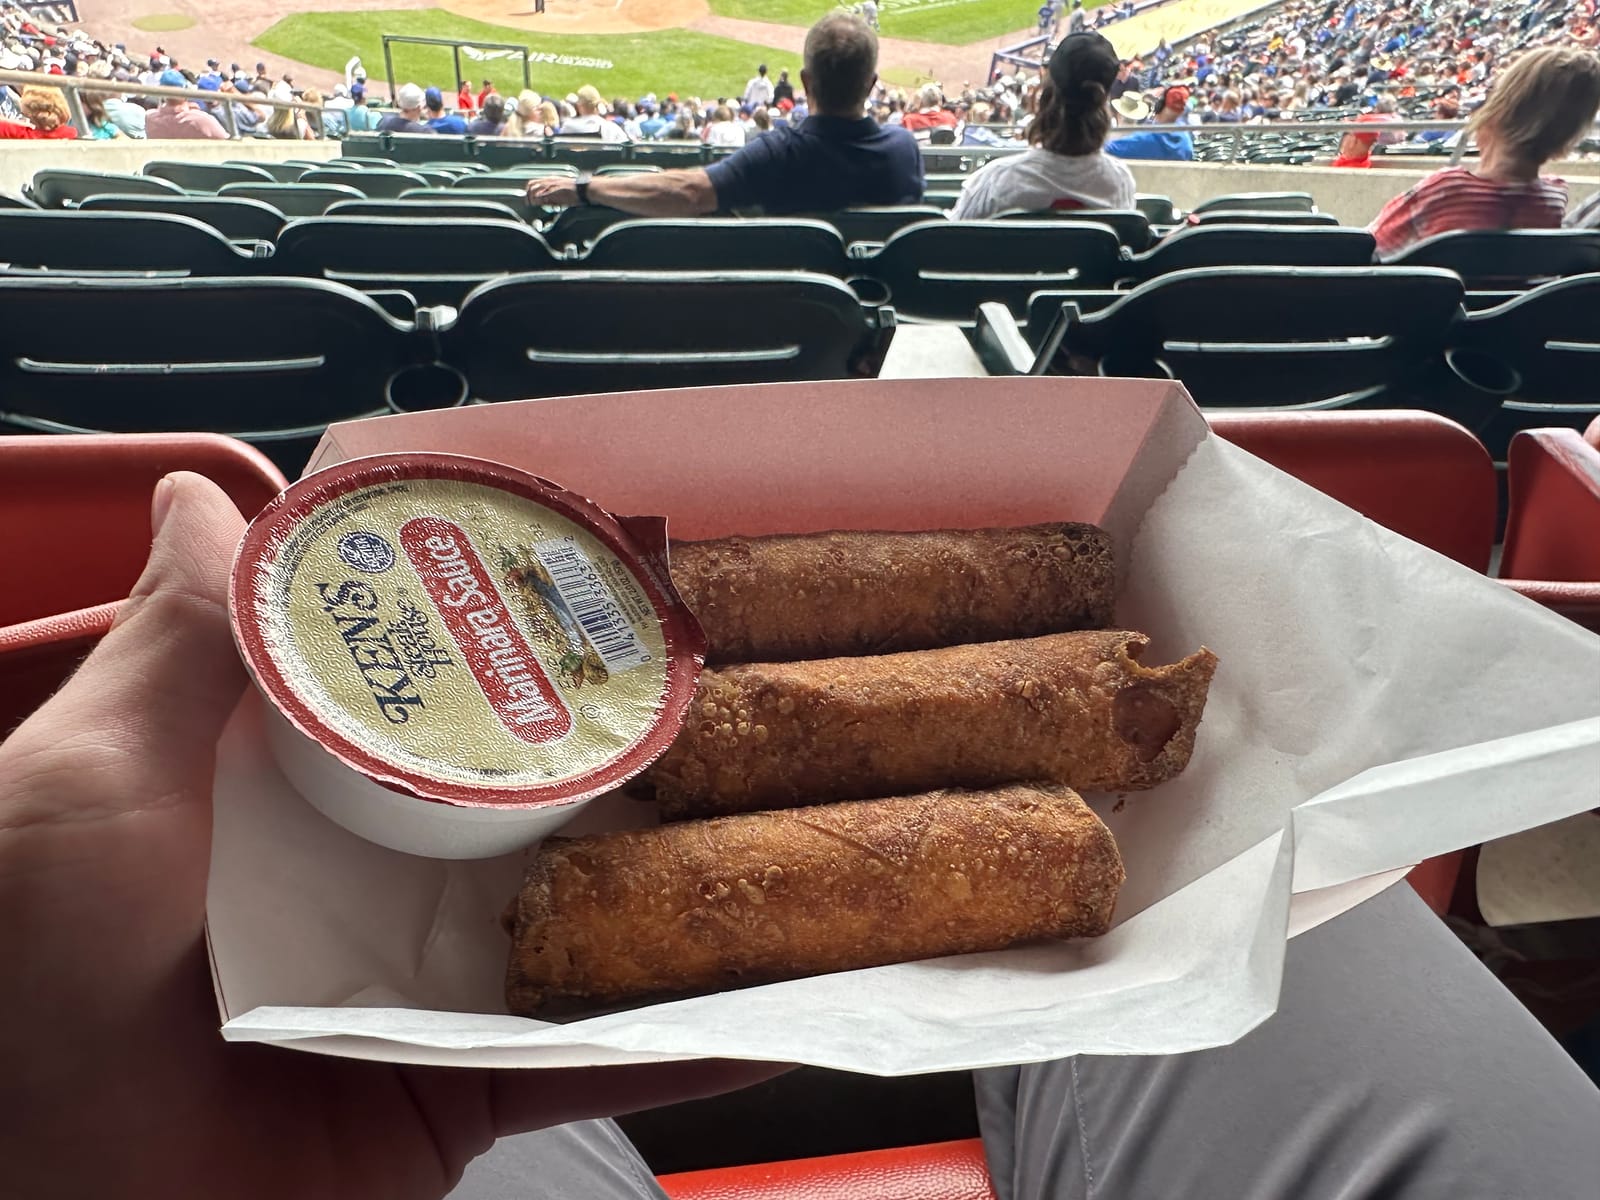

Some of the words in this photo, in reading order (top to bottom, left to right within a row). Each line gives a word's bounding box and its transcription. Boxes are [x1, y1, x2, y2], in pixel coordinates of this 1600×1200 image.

[424, 535, 487, 607] Sauce
[314, 580, 426, 724] KEN'S
[387, 620, 437, 678] Steak
[397, 598, 454, 667] House
[467, 609, 556, 726] Marinara
